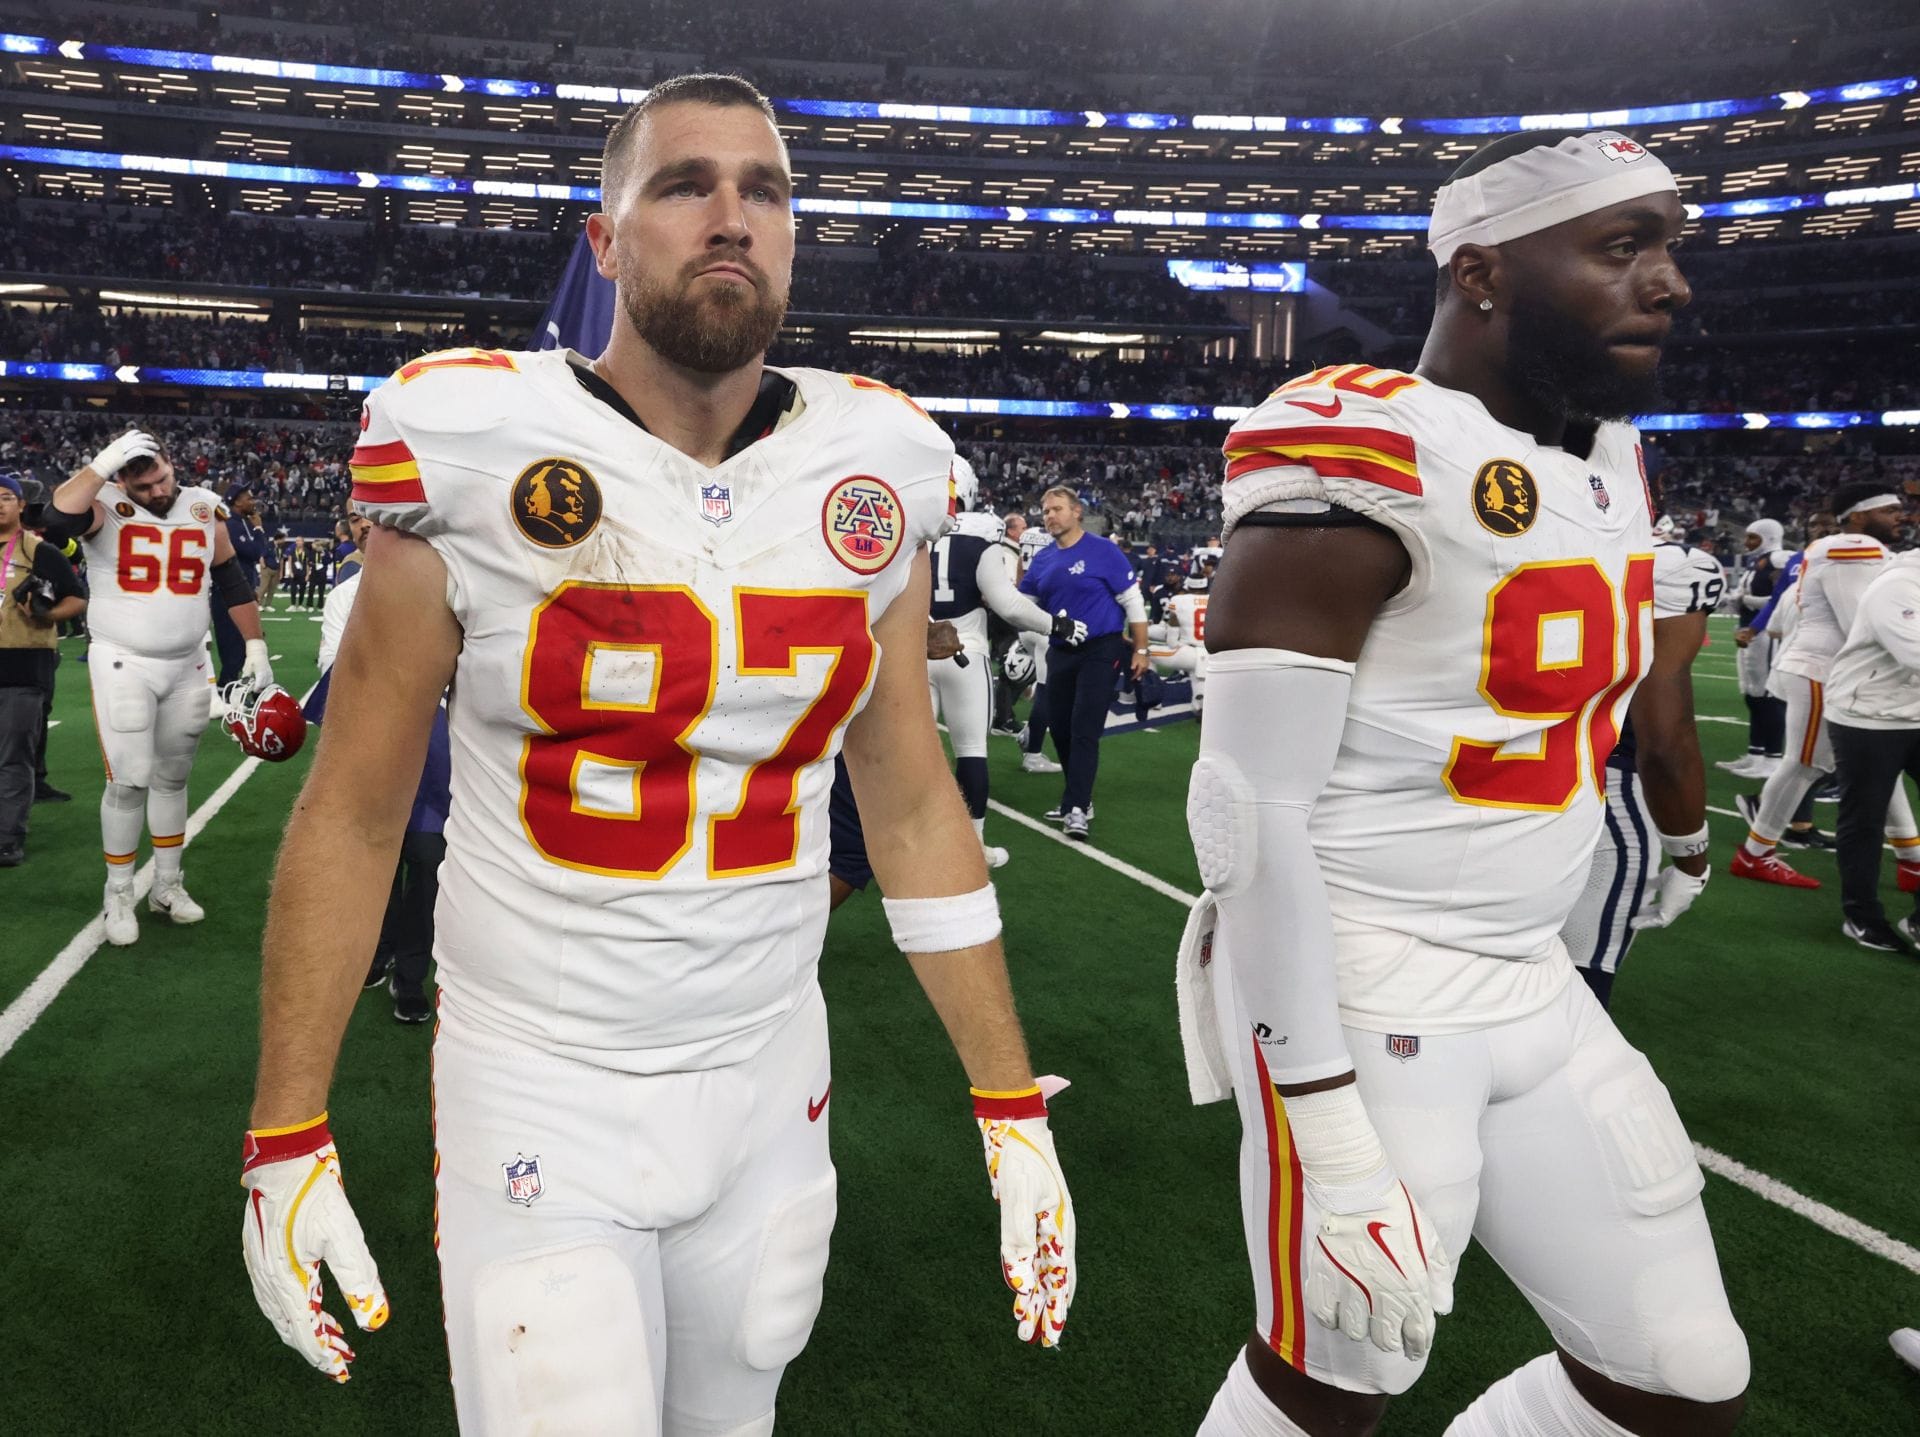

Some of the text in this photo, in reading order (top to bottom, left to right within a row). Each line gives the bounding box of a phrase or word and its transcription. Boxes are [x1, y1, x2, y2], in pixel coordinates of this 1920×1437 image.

[704, 499, 730, 517] NFL
[855, 537, 873, 553] LH
[117, 523, 208, 597] 66
[1686, 578, 1724, 614] 19
[519, 579, 878, 881] 87
[1392, 1038, 1416, 1055] NFL
[511, 1176, 539, 1197] NFL
